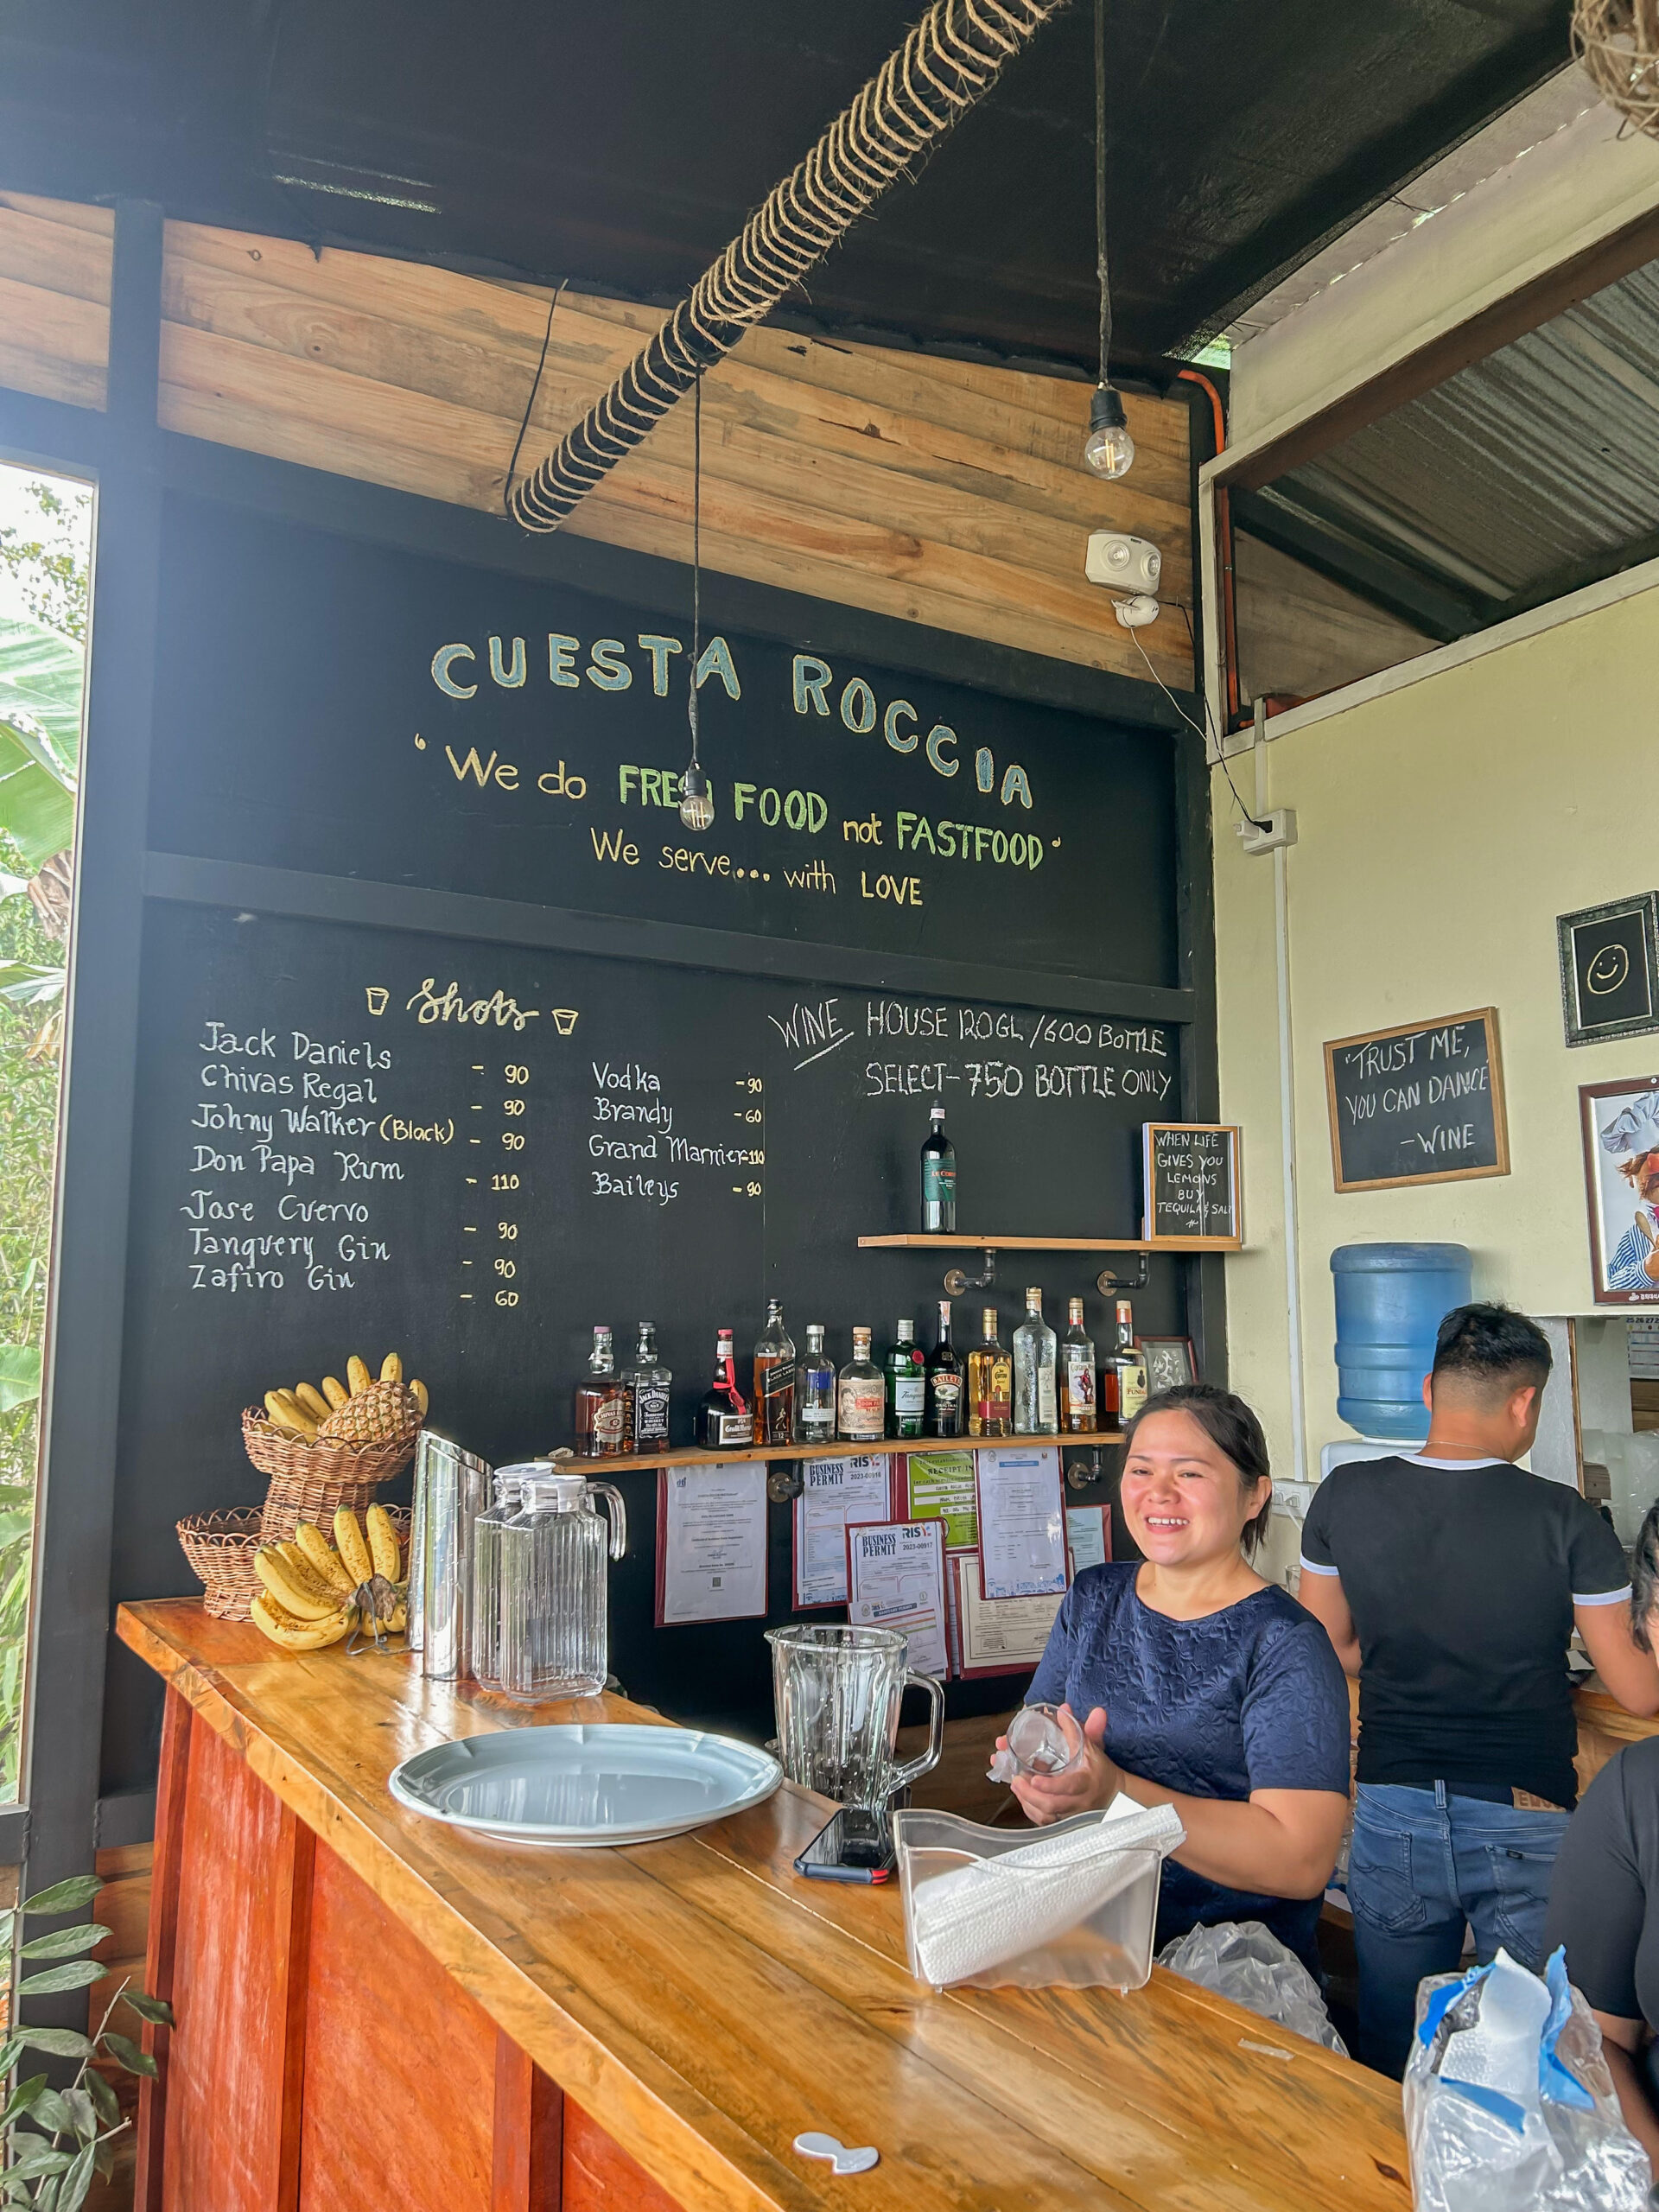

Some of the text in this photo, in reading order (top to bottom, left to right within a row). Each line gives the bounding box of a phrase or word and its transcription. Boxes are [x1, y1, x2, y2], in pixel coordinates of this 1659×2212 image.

[432, 635, 1033, 810] CUESTA ROCCIA
[537, 760, 586, 799] do
[620, 765, 714, 809] FRE
[734, 783, 827, 834] FOOD
[843, 812, 883, 846] not
[590, 827, 640, 866] We
[784, 862, 836, 895] with
[861, 872, 924, 906] LOVE
[405, 977, 540, 1031] Shots
[768, 999, 844, 1049] WINE
[867, 1001, 949, 1038] HOUSE
[199, 1021, 392, 1070] Jack Daniels
[200, 1064, 378, 1109] Chivas Regal
[504, 1065, 530, 1085] 90
[592, 1061, 661, 1092] Vodka
[1036, 1064, 1116, 1098] BOTTLE
[1122, 1069, 1172, 1101] ONLY
[503, 1099, 525, 1116] 90
[593, 1096, 672, 1134] Brandy
[1345, 1093, 1376, 1126] YOU
[1382, 1081, 1421, 1113] CAN
[191, 1103, 454, 1144] Johny Walker (Black)
[501, 1133, 525, 1151] 90
[588, 1135, 658, 1160] Grand
[1154, 1131, 1219, 1147] WHEN LIFE
[189, 1144, 405, 1186] Don Papa Rum
[1157, 1153, 1224, 1170] GIVES YOU
[491, 1174, 519, 1191] 110
[591, 1171, 680, 1206] Baileys
[1167, 1173, 1217, 1185] LEMONS
[180, 1189, 255, 1221] Jose
[1156, 1202, 1201, 1216] TEQUILA
[1178, 1189, 1204, 1203] BUY
[497, 1222, 518, 1241] 90
[338, 1234, 391, 1262] Gin
[188, 1264, 356, 1293] Zafiro Gin
[494, 1258, 516, 1279] 90
[494, 1290, 518, 1306] 60
[810, 1463, 843, 1475] BUSINESS
[810, 1474, 843, 1486] PERMIT
[862, 1534, 896, 1547] BUSINESS
[863, 1544, 896, 1557] PERMIT
